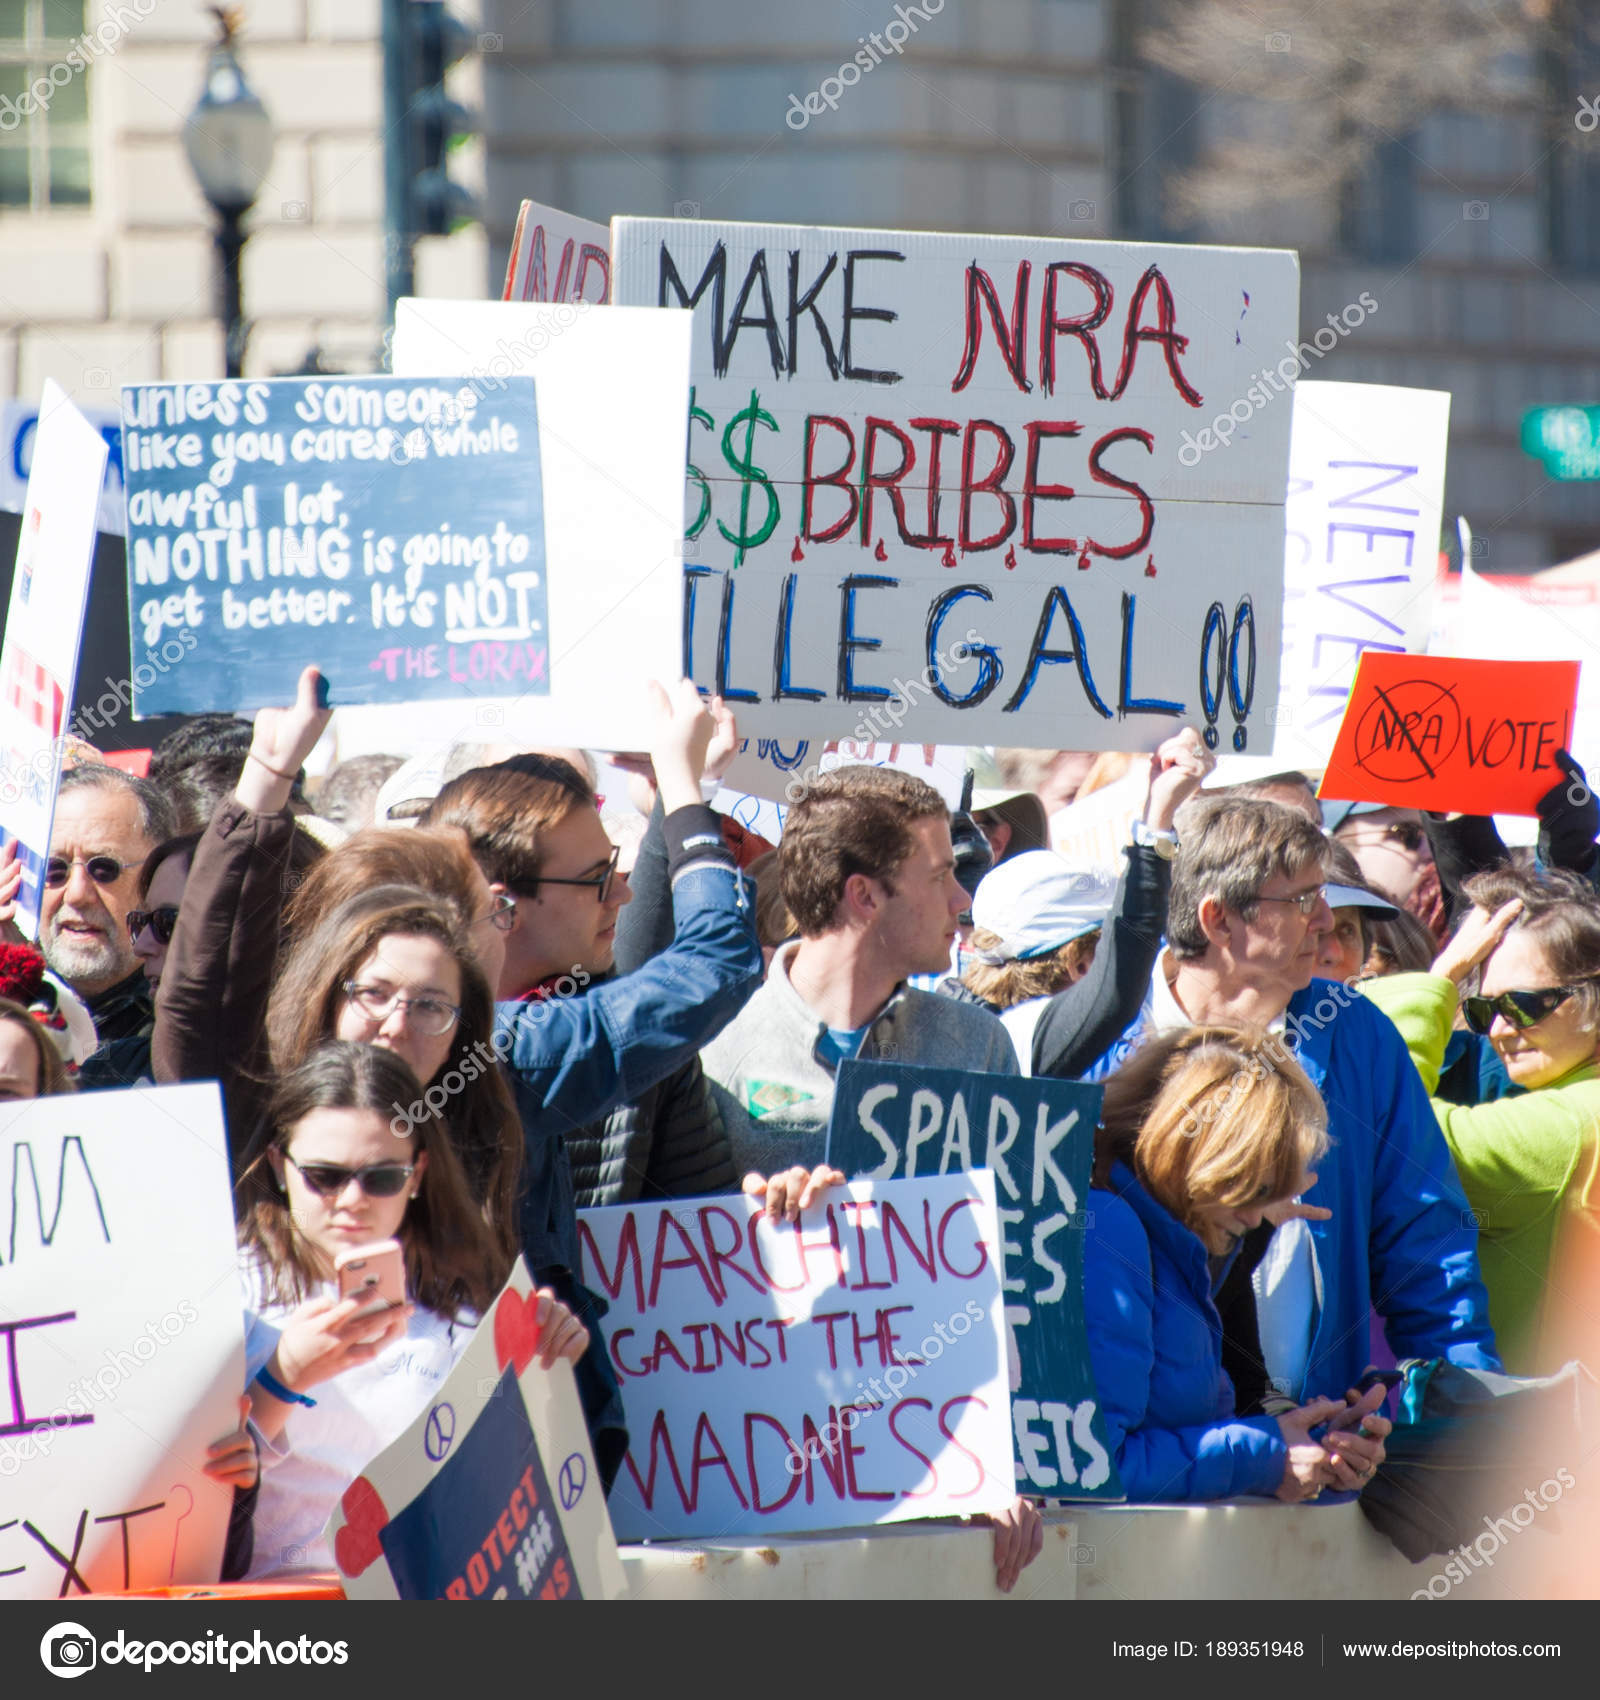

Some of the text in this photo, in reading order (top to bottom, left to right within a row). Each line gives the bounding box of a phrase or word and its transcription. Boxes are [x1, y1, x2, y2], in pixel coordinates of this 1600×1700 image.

[658, 239, 1204, 408] MAKE NRA
[122, 382, 478, 428] unless someone
[127, 430, 202, 472] like
[211, 430, 286, 486] you
[289, 426, 391, 463] cares
[402, 427, 428, 460] a
[432, 415, 520, 458] whole
[128, 481, 349, 530] awful lot,
[802, 413, 1156, 560] BRIBES
[134, 520, 529, 600] NOTHING is going to
[139, 570, 543, 648] get better. It's NOT.
[448, 641, 547, 684] LORAX
[857, 1082, 1080, 1213] SPARK
[0, 1135, 111, 1267] M
[576, 1198, 990, 1314] MARCHING
[616, 1305, 928, 1387] GAINST THE
[624, 1394, 990, 1515] MADNESS
[1013, 1399, 1111, 1491] ETS
[436, 1463, 539, 1600] ROTECT
